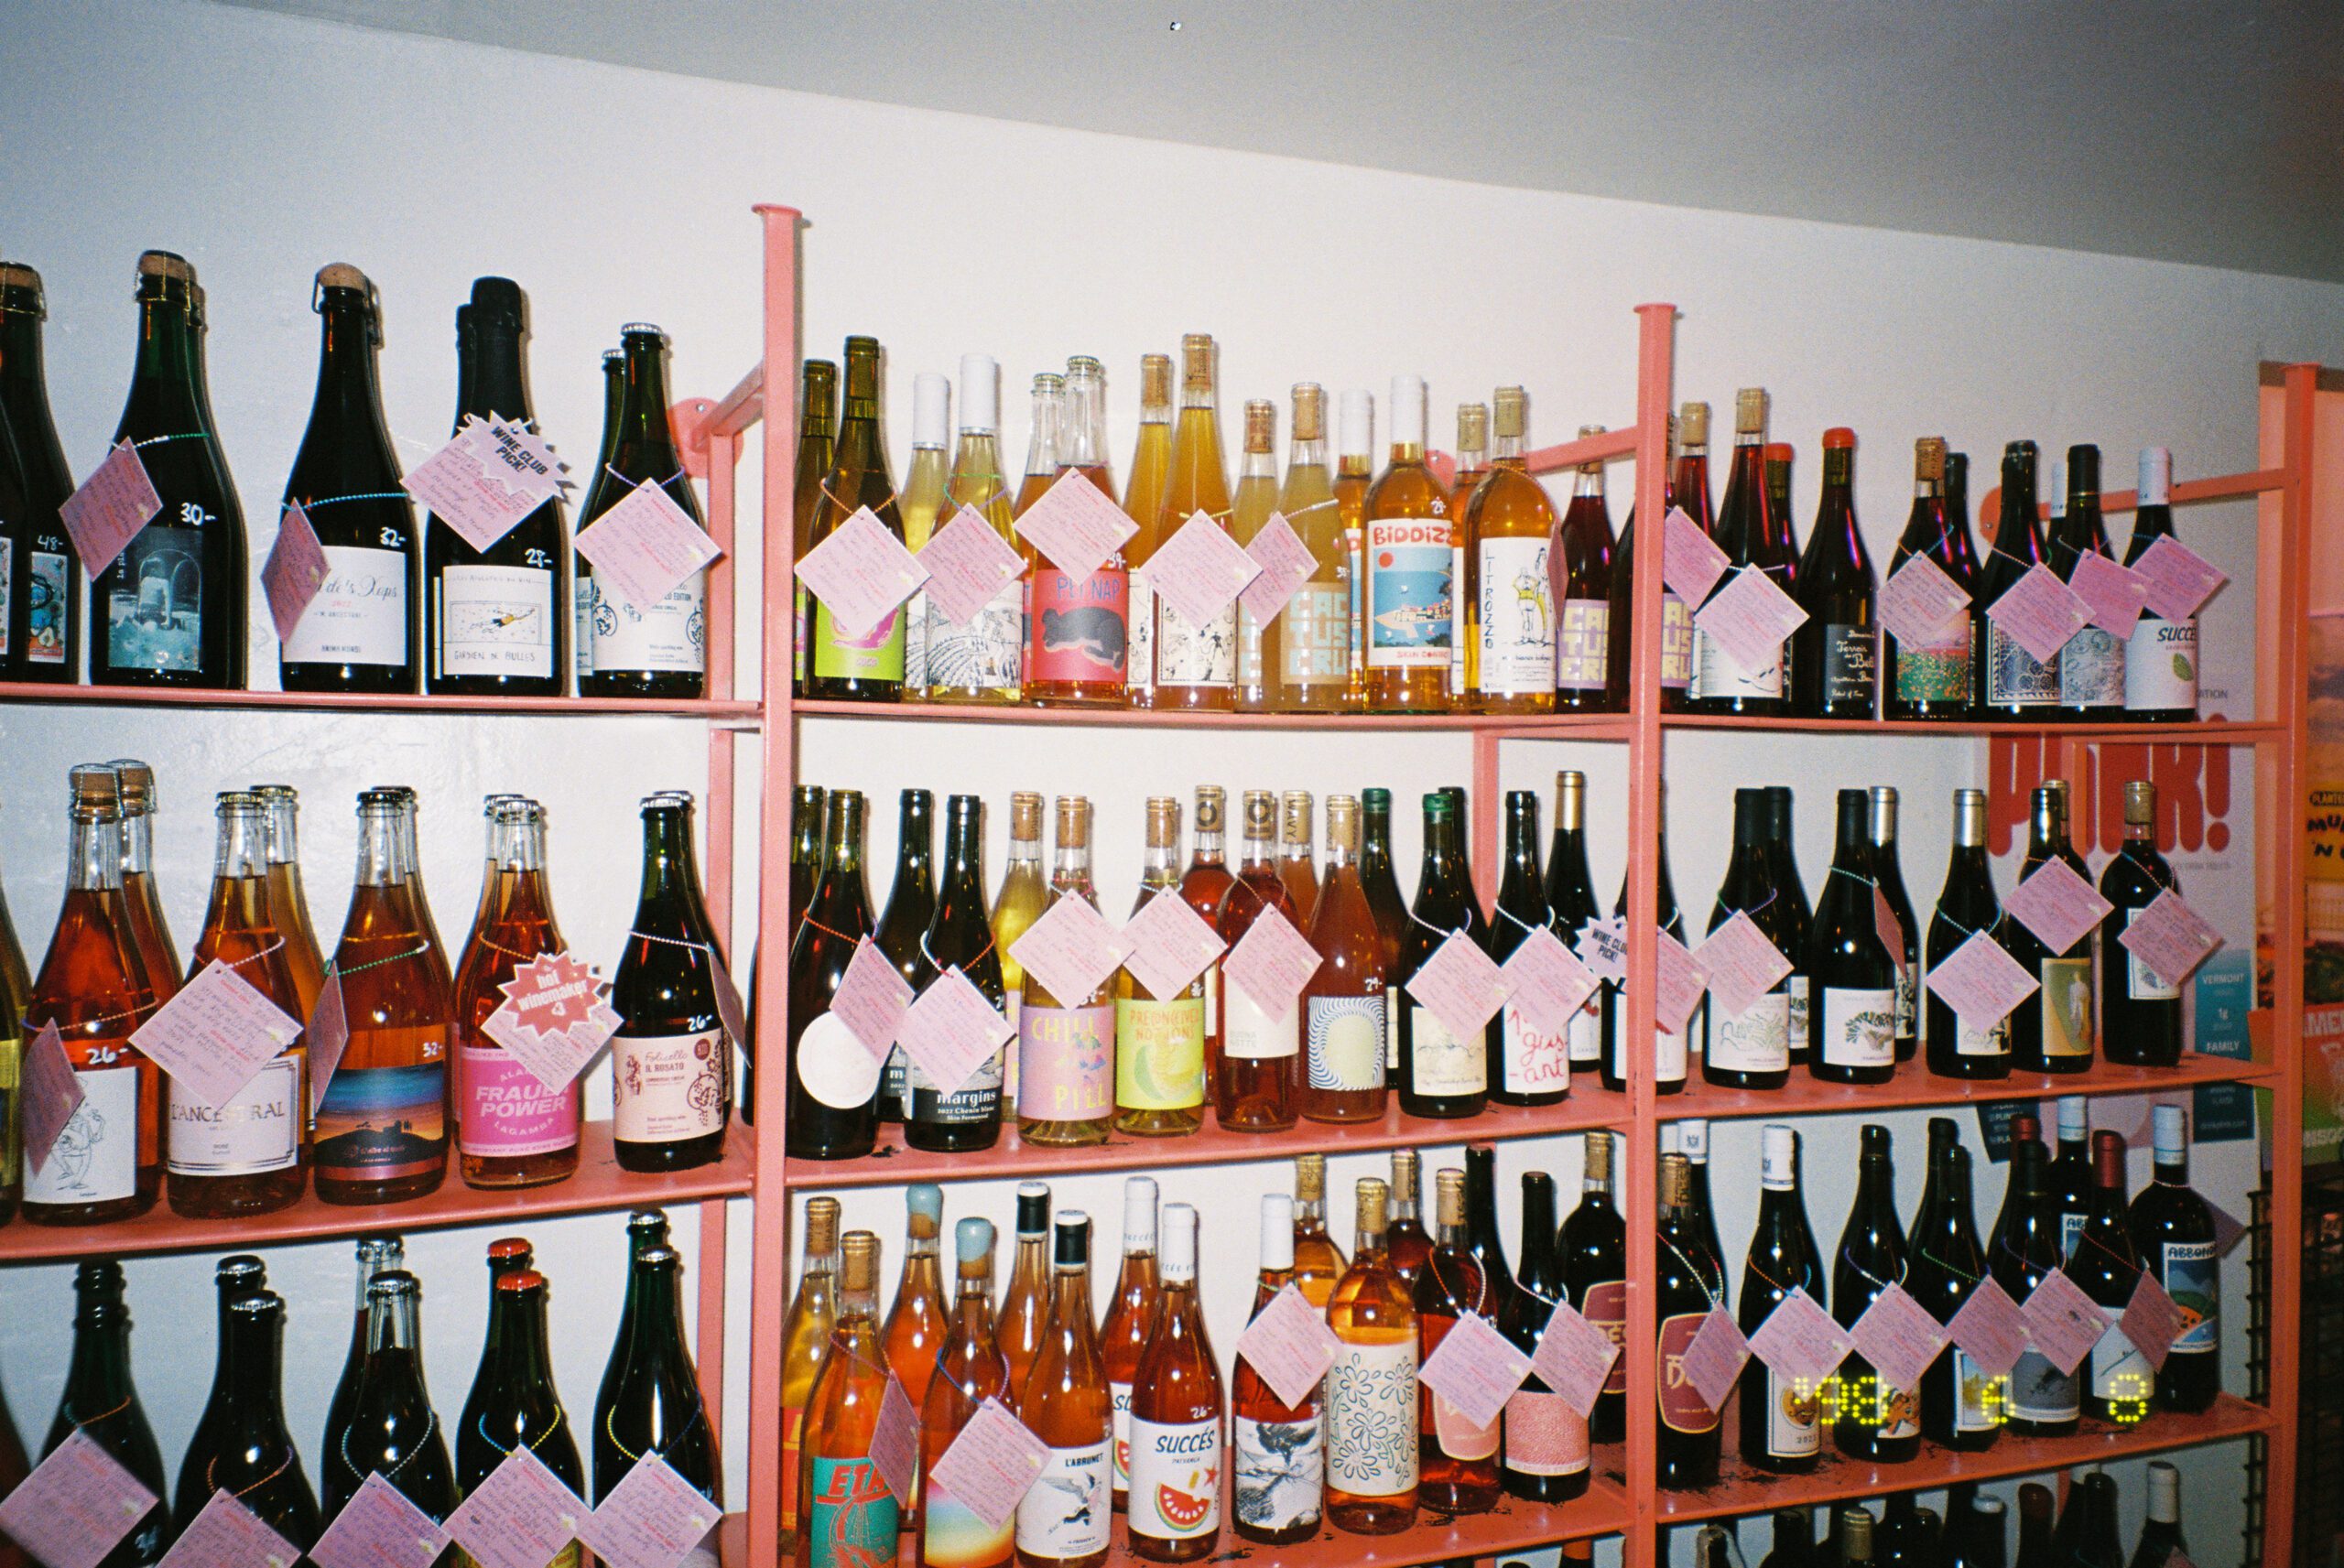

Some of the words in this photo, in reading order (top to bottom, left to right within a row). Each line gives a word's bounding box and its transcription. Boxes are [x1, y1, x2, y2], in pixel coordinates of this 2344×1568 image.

[491, 425, 522, 452] WINE
[517, 449, 549, 475] CLUB
[494, 446, 528, 473] PICK!
[1592, 927, 1612, 946] WINE
[1612, 938, 1627, 955] CLU
[1597, 945, 1620, 962] PICK!
[2202, 974, 2244, 985] VERMONT
[517, 979, 589, 1012] winemaker
[1031, 1016, 1095, 1042] CHILL
[2207, 1041, 2241, 1053] FAMILY
[480, 1097, 567, 1118] POWER
[937, 1090, 997, 1108] margins
[1057, 1083, 1108, 1111] PILL
[1156, 1426, 1216, 1454] SUCCÉS
